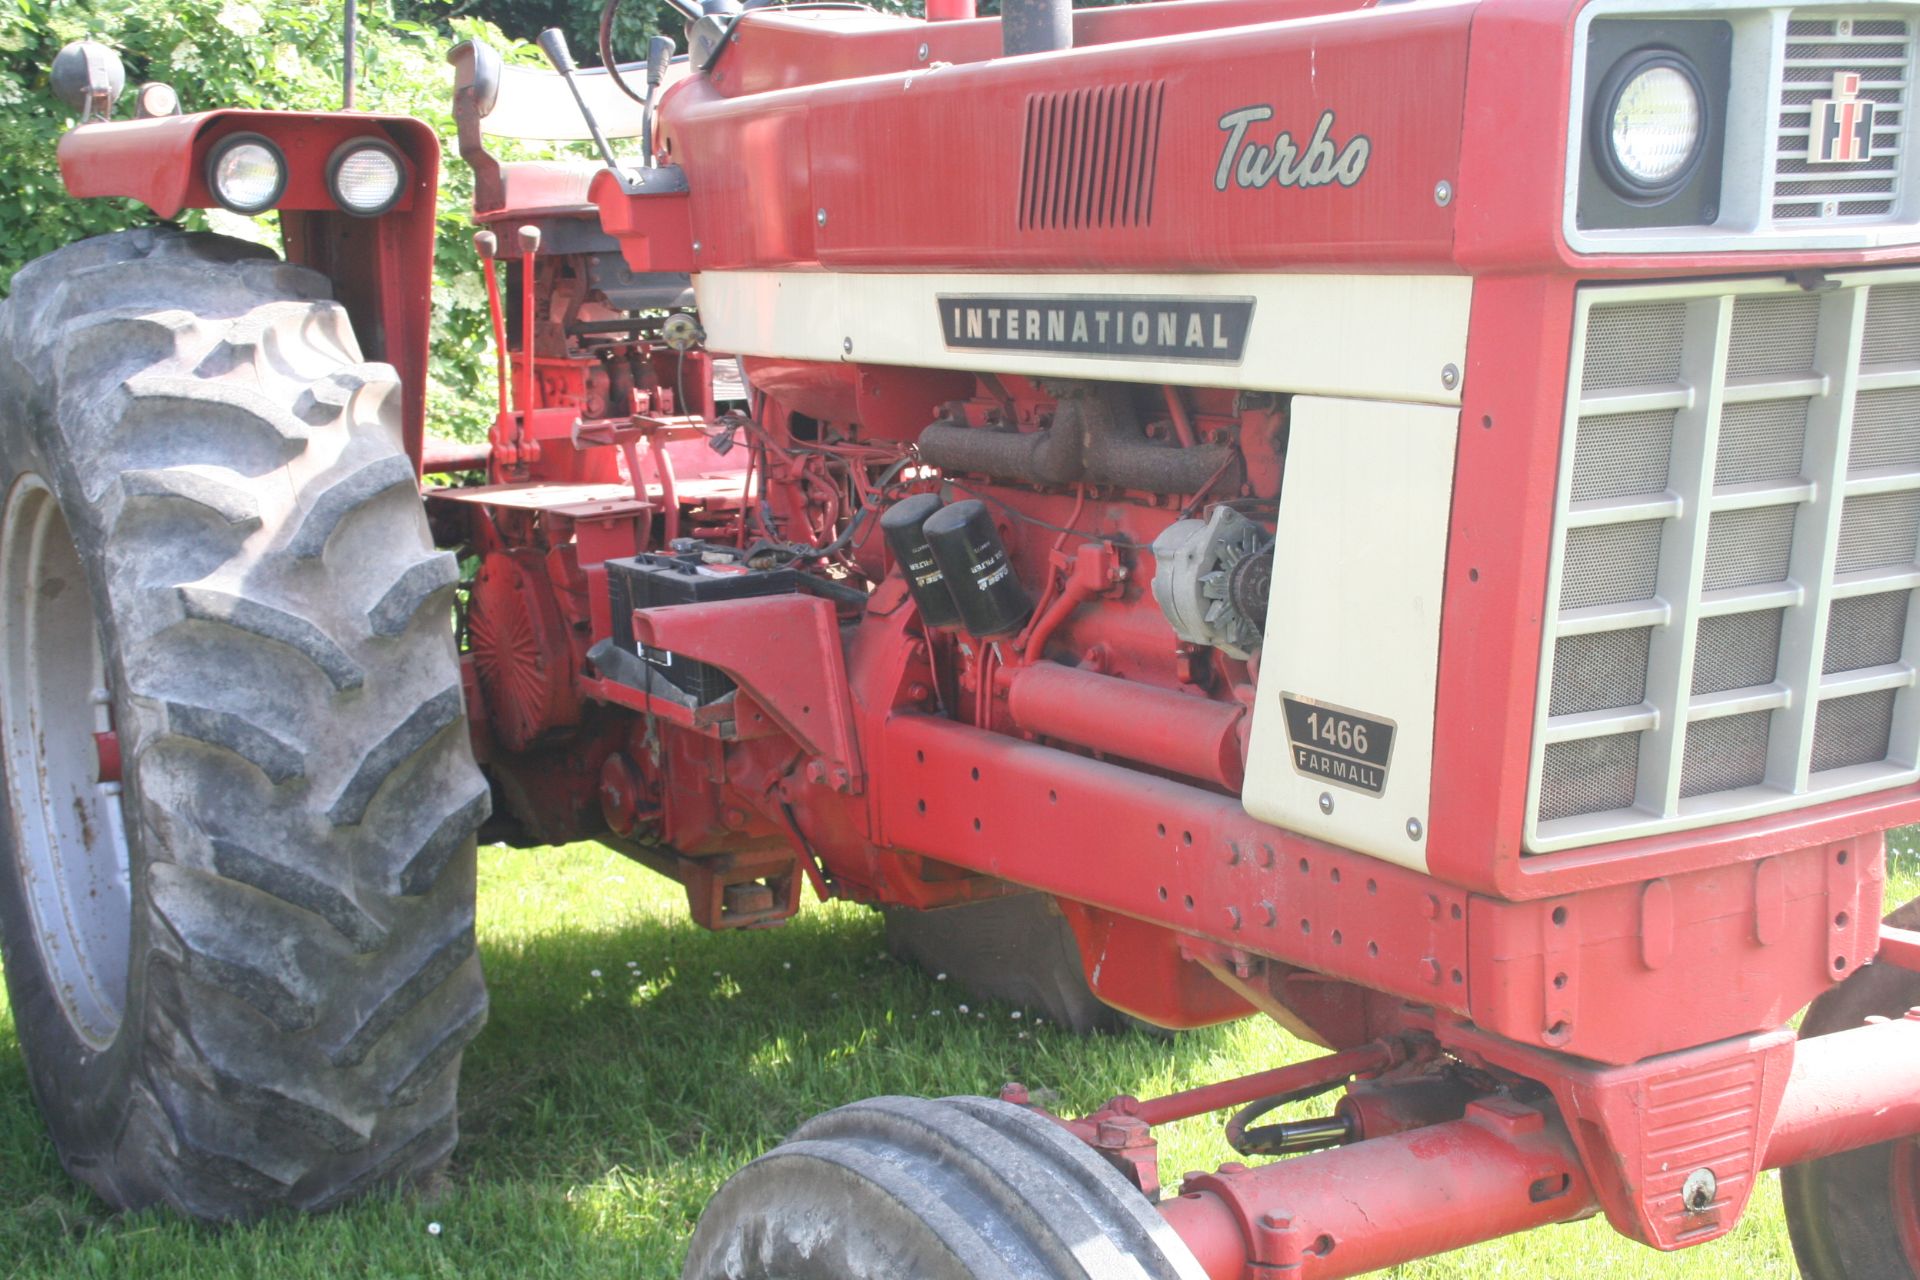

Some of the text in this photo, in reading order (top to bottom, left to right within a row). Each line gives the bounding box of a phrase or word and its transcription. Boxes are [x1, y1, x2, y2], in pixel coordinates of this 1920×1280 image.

[1214, 104, 1372, 191] Turbo
[954, 307, 1229, 349] INTERNATIONAL
[1307, 712, 1368, 754] 1466
[1299, 750, 1377, 787] FARMALL
